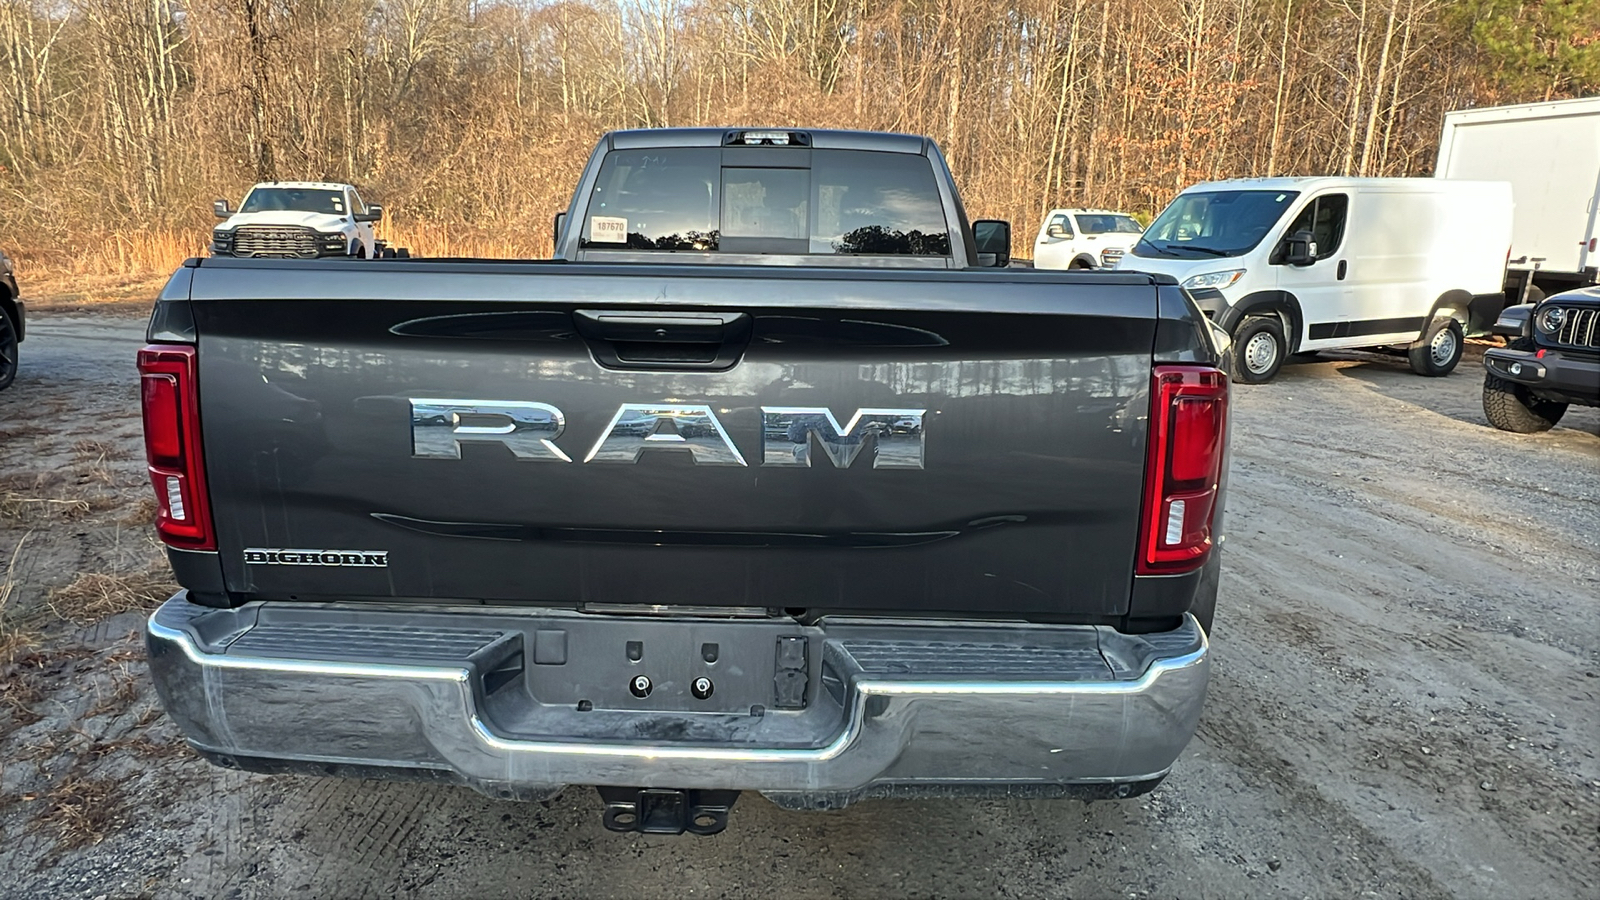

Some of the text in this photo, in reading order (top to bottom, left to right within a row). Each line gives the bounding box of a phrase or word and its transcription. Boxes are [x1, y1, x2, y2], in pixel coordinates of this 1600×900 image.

[598, 222, 625, 231] 187670
[408, 397, 928, 470] RAM
[243, 547, 389, 568] BIGHORN
